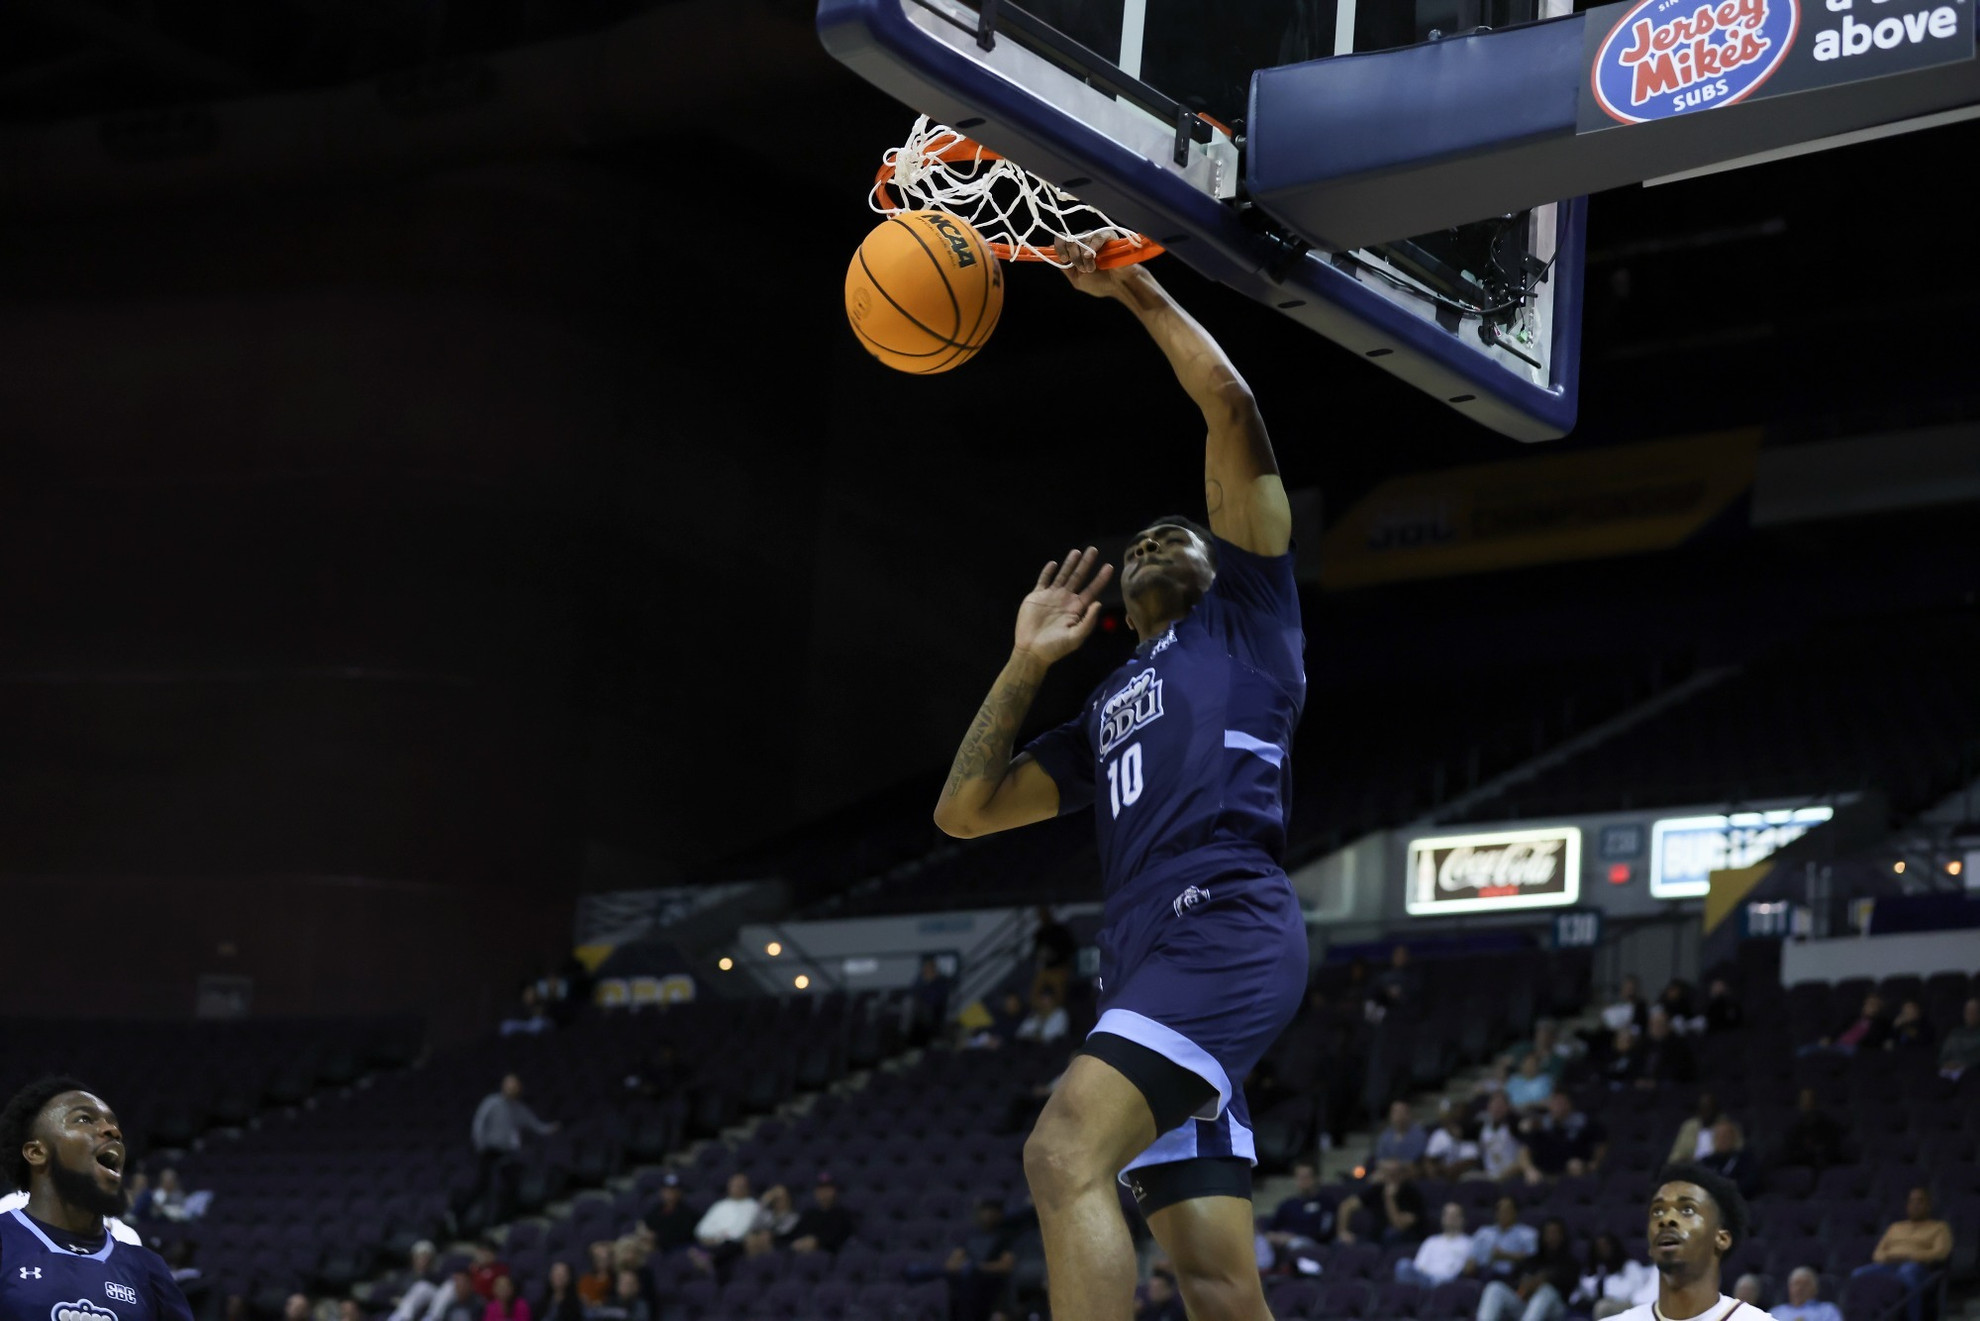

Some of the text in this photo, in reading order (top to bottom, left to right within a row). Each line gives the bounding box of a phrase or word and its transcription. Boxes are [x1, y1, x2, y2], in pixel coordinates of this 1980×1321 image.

[1620, 0, 1769, 65] Jersey
[1813, 6, 1957, 61] above
[1632, 29, 1770, 104] Mike's
[1673, 79, 1729, 112] SUBS
[920, 214, 977, 268] NCAA
[1100, 690, 1157, 754] ODU
[1107, 741, 1143, 820] 10
[105, 1281, 137, 1305] SBC
